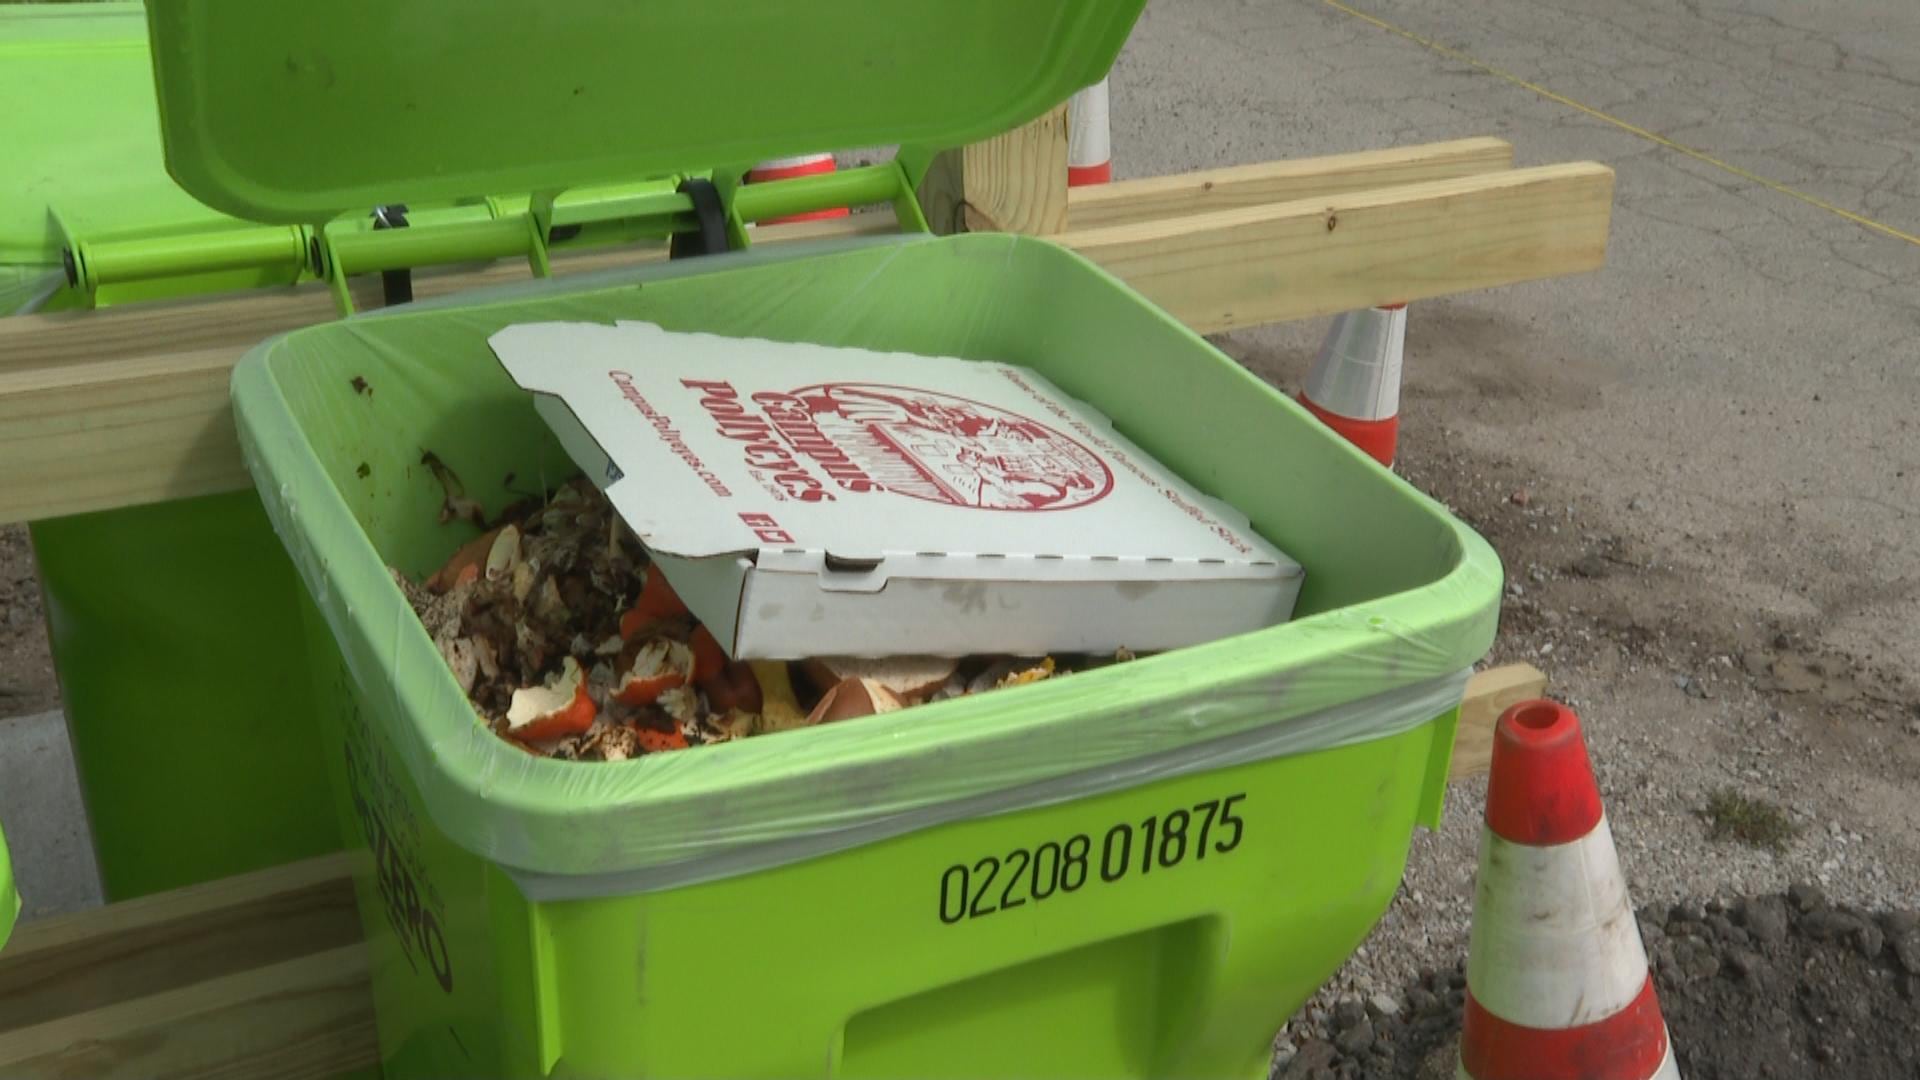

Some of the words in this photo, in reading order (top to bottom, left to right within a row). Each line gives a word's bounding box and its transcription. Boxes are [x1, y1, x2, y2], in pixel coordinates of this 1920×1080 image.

[608, 370, 732, 497] CampusPollyeyes.com
[679, 377, 837, 503] Pollyeyes
[751, 391, 884, 492] Campus
